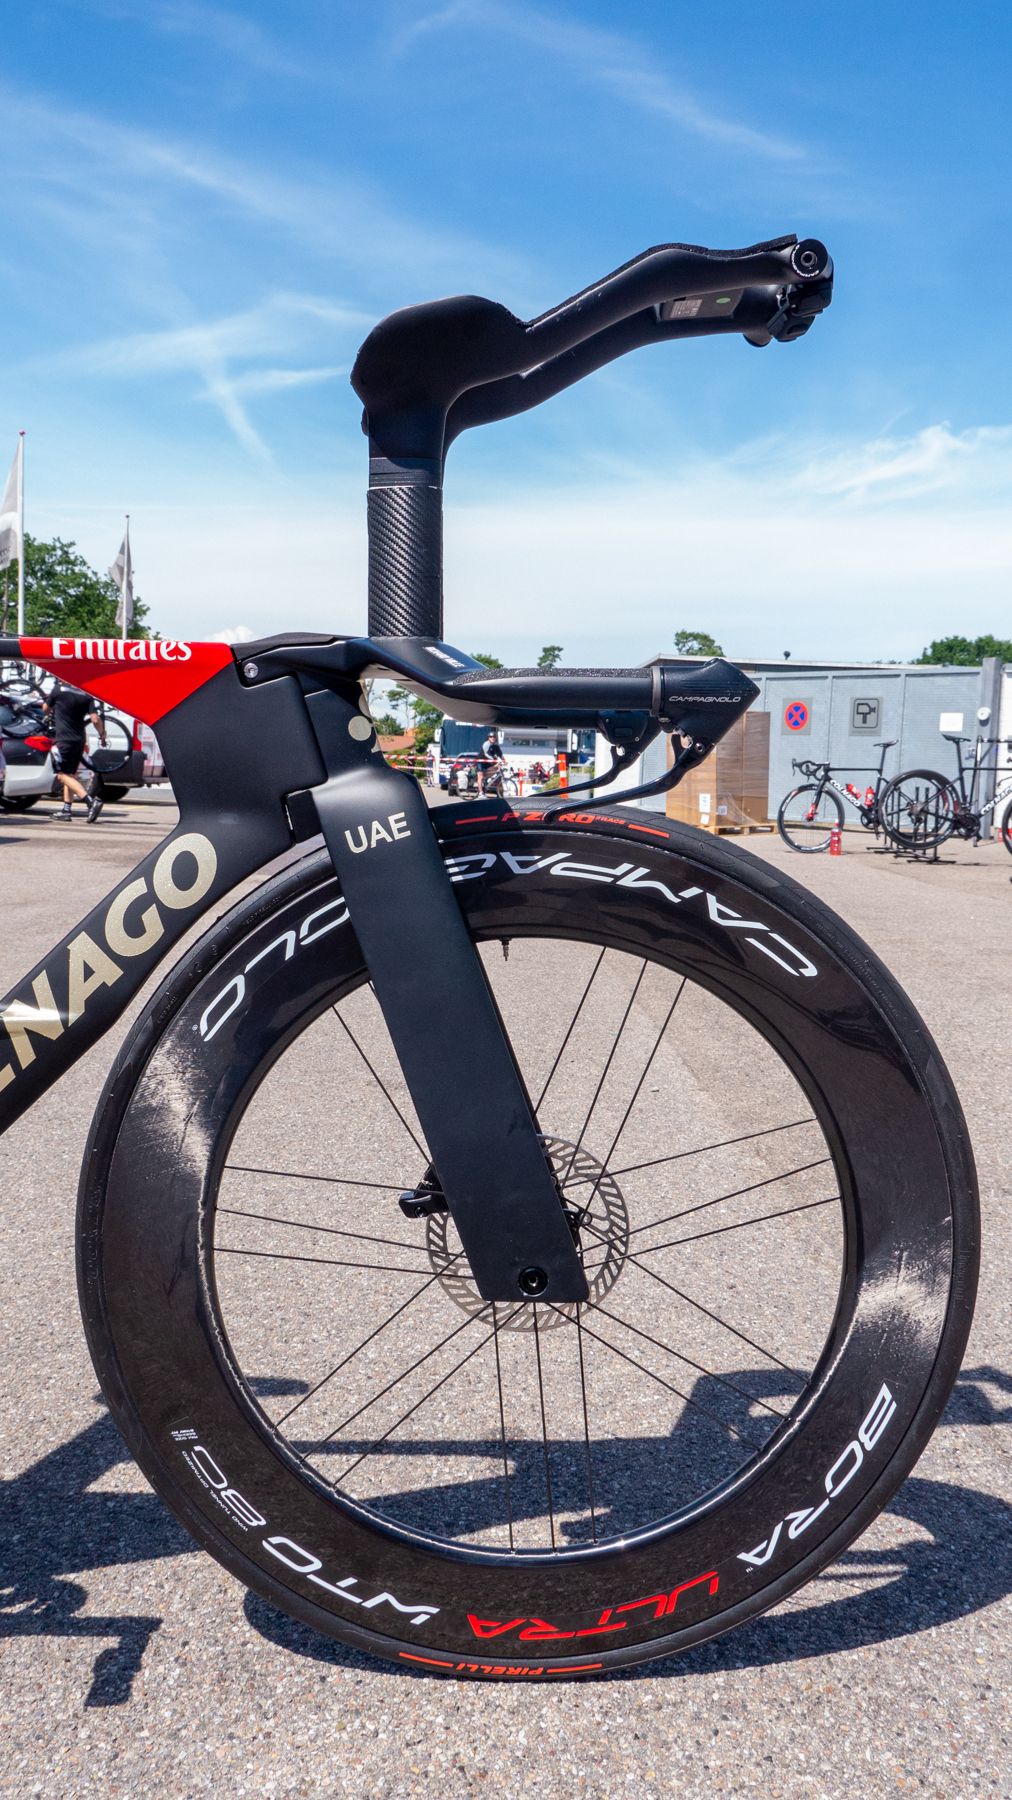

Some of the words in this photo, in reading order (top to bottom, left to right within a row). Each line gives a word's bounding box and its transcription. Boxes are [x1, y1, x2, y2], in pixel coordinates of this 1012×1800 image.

[52, 637, 192, 661] Emirates
[668, 695, 741, 703] CAMPAGNOLO
[344, 811, 411, 853] UAE
[523, 811, 595, 824] ZRO
[0, 832, 217, 1092] NAGO
[181, 1450, 209, 1488] OPTIMIZED
[736, 1382, 897, 1566] BORA
[209, 1489, 231, 1514] TUNNEL
[231, 1515, 248, 1532] WIND
[262, 1536, 441, 1625] WTO
[467, 1570, 720, 1641] ULTRA
[456, 1663, 544, 1676] PIRELLI
